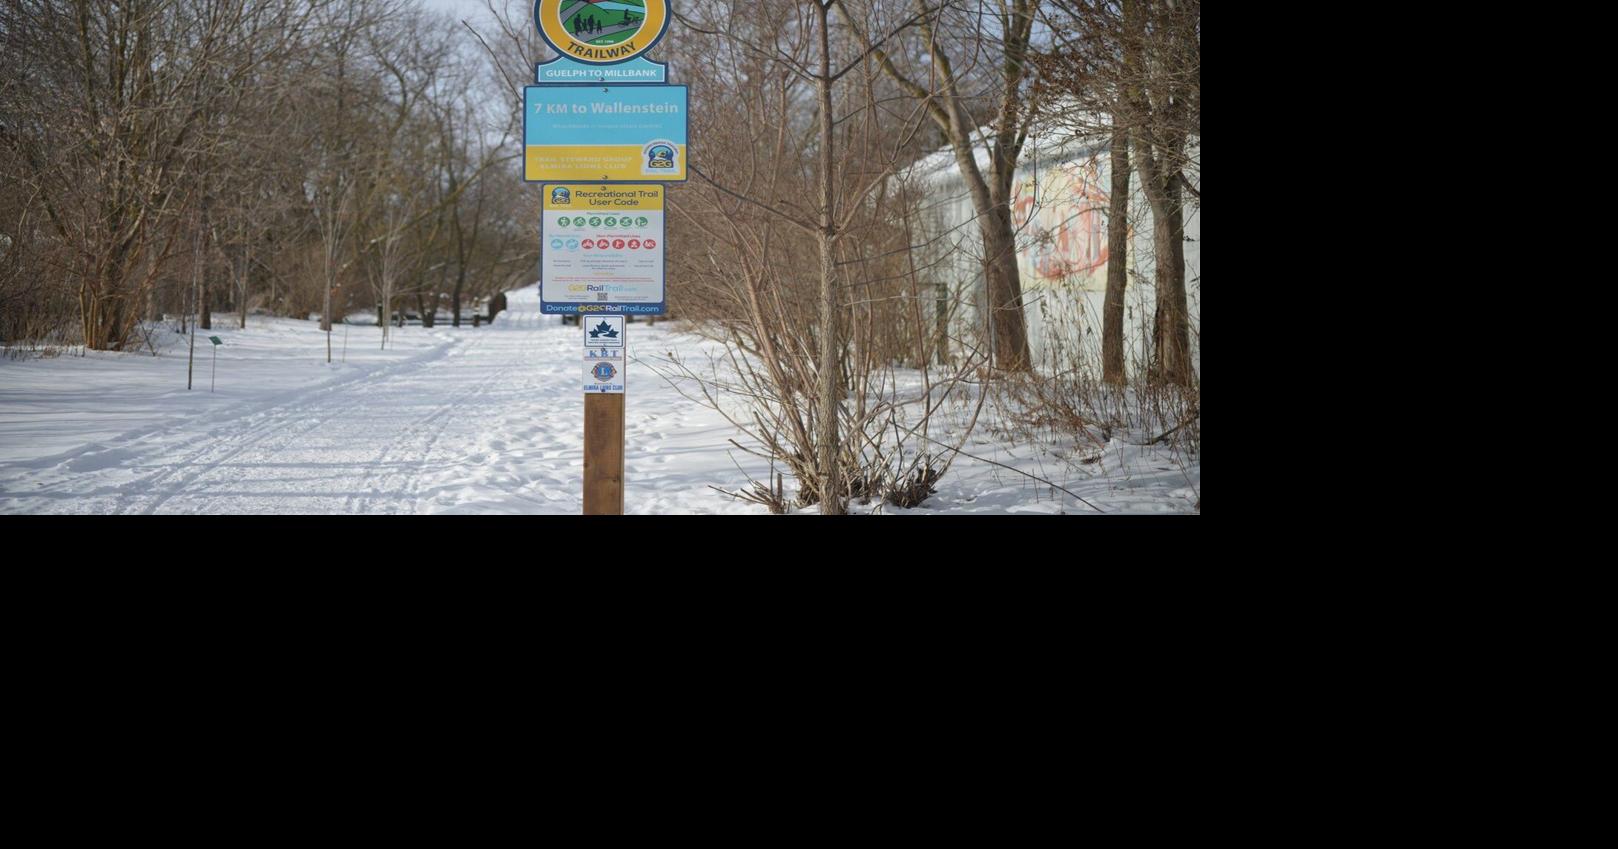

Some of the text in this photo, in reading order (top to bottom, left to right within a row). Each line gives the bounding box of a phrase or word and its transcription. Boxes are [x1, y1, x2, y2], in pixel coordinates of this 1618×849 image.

[567, 41, 637, 59] TRAILWAY
[546, 69, 657, 77] GUELPH TO MILLBANK
[534, 102, 679, 114] 7 KM to Wallenstein
[575, 190, 659, 198] Recreational Trail
